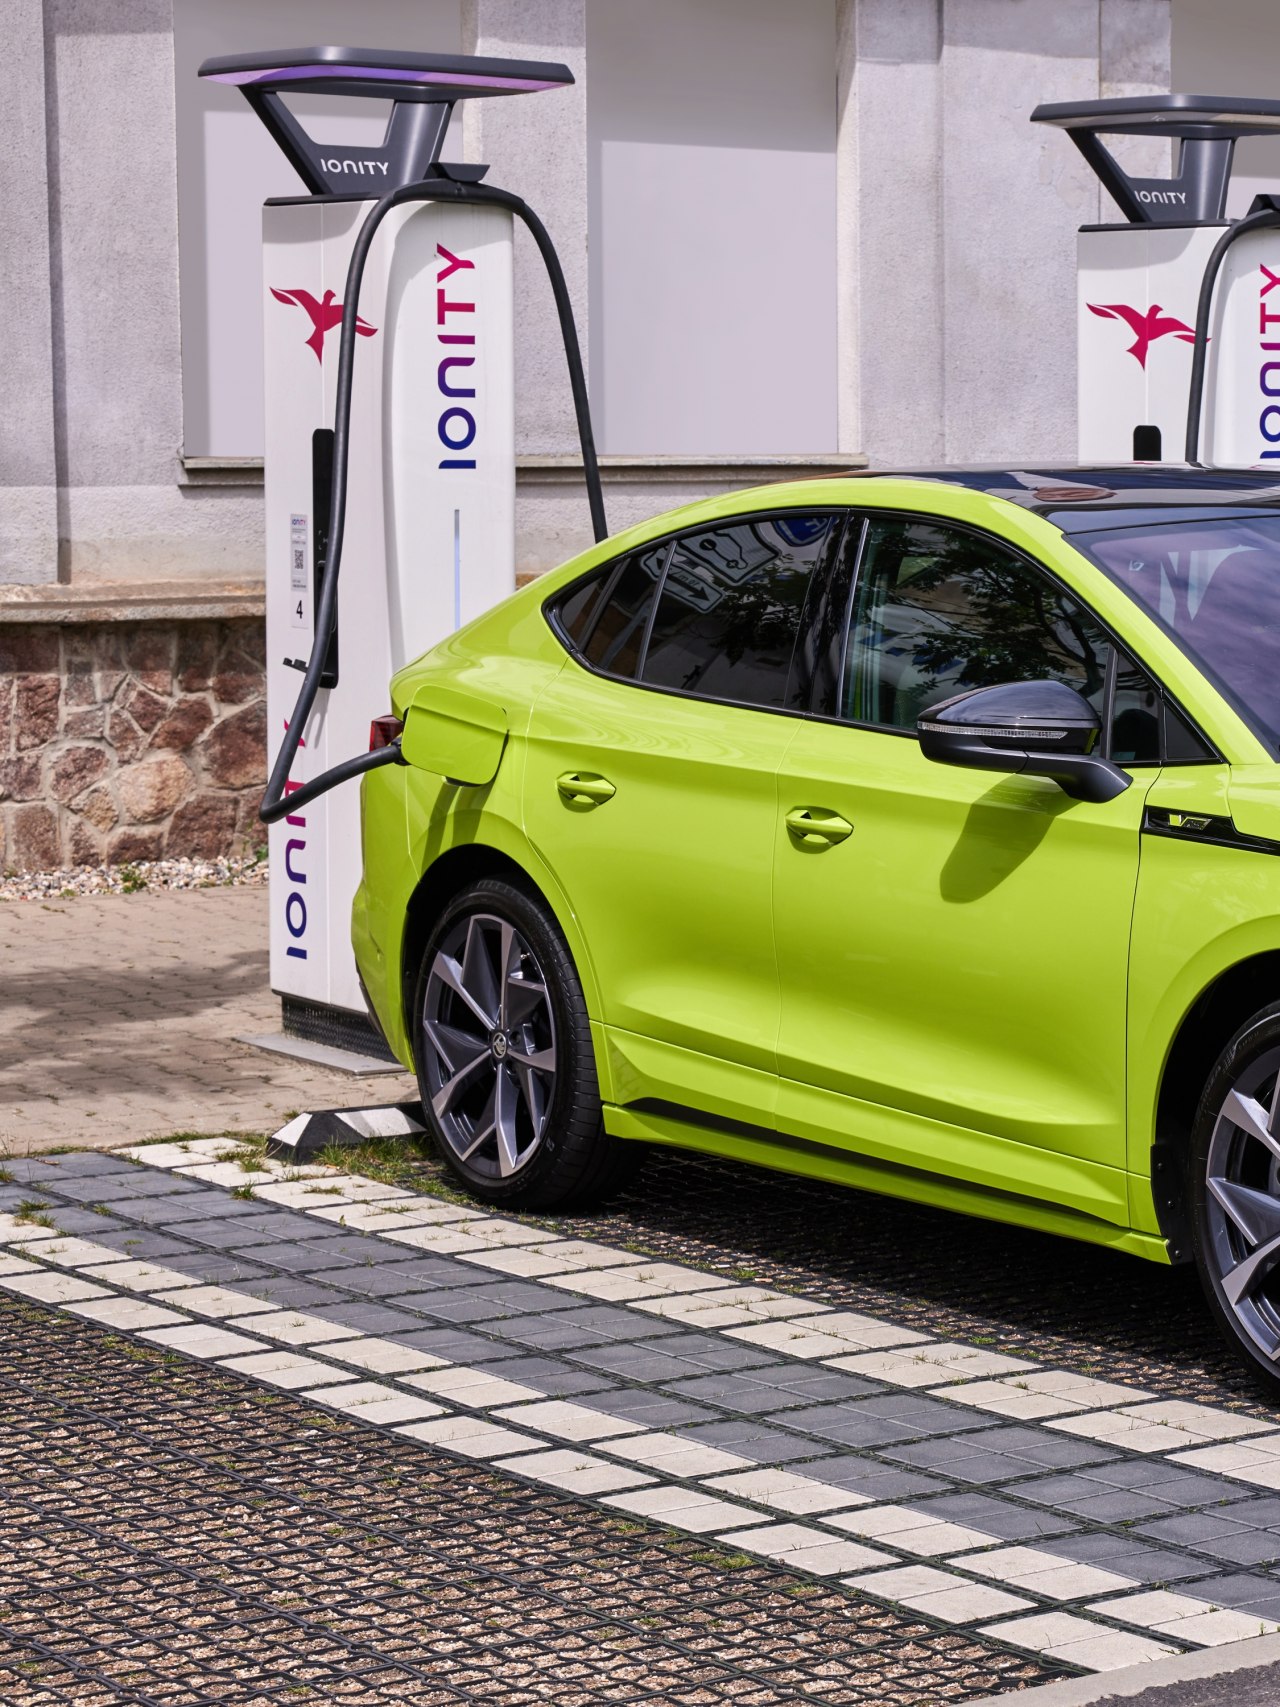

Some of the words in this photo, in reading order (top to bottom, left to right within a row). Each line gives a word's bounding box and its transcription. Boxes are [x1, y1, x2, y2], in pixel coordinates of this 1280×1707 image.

[320, 158, 389, 175] IONITY
[1134, 190, 1186, 204] IONITY
[437, 242, 476, 469] IONITY
[296, 599, 303, 619] 4
